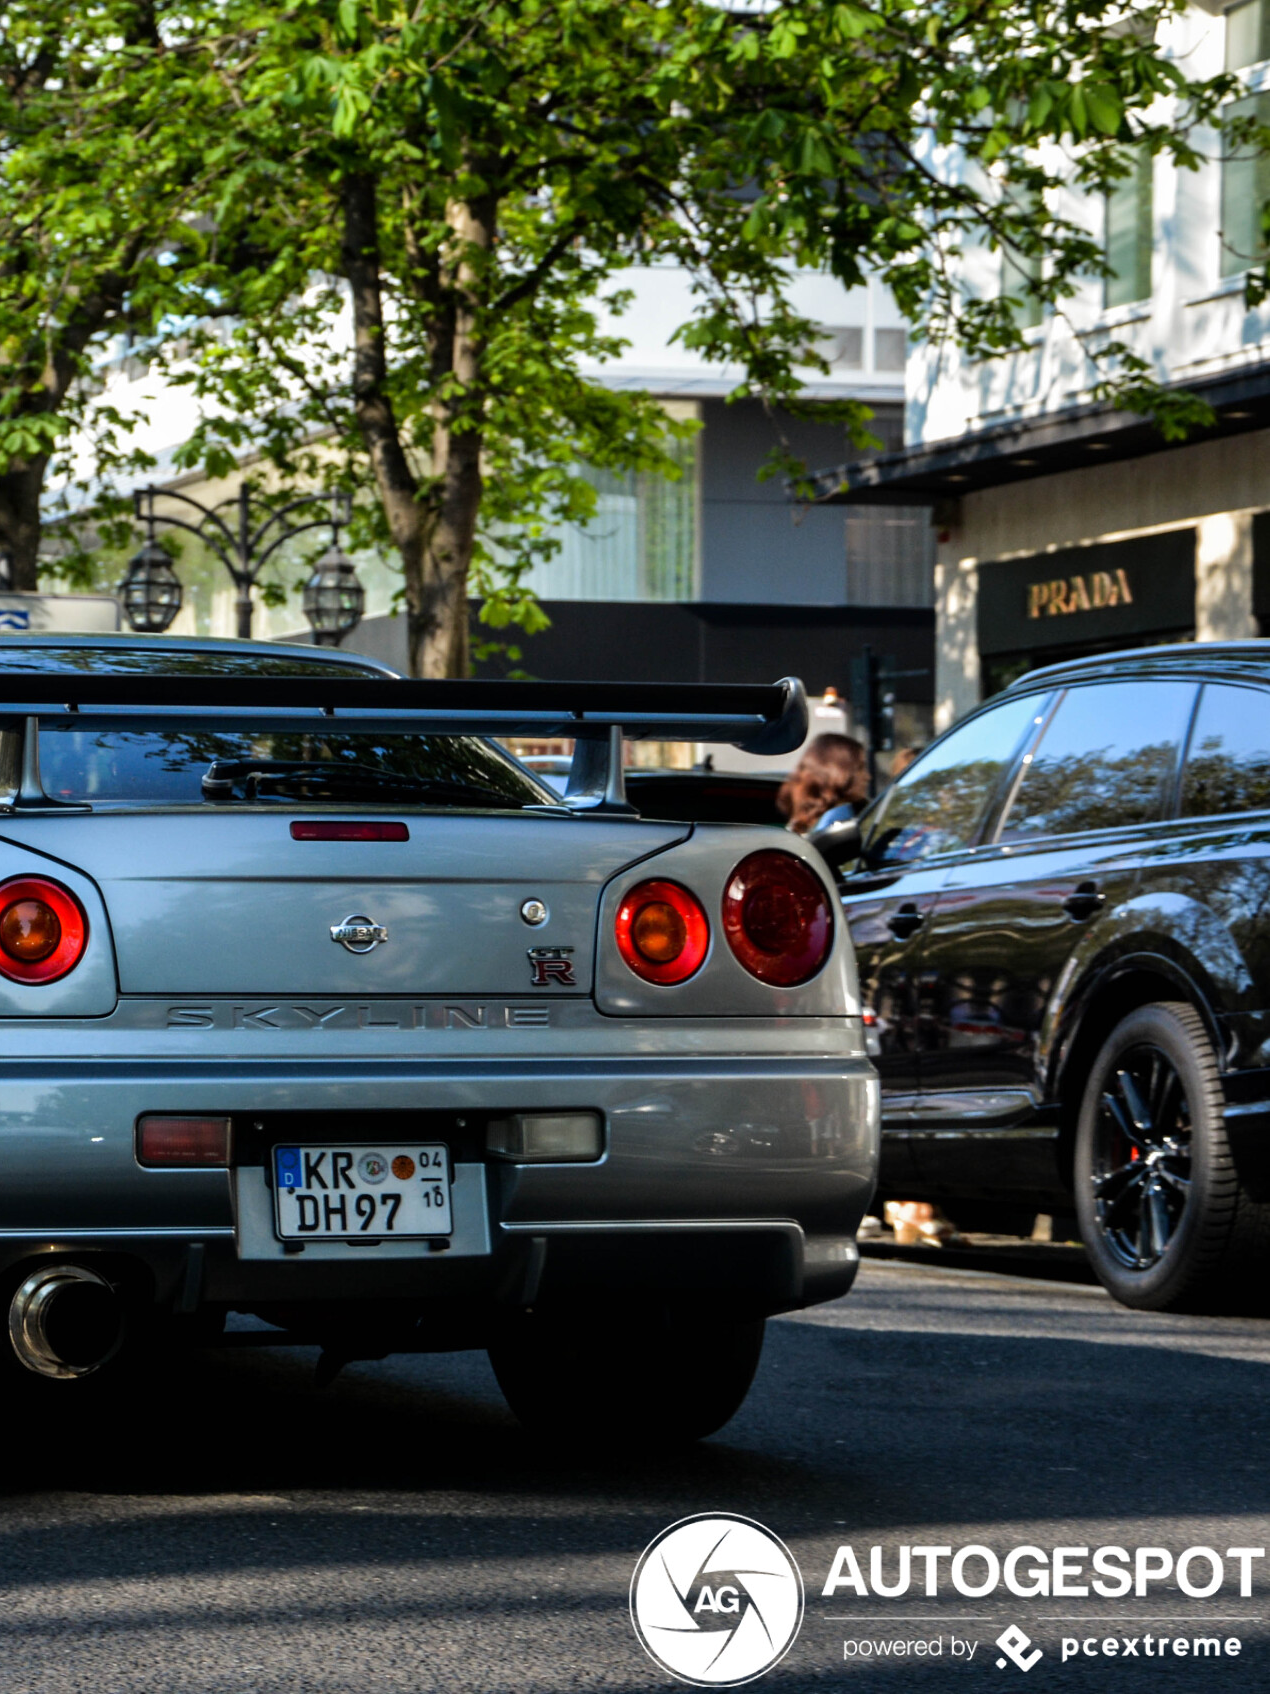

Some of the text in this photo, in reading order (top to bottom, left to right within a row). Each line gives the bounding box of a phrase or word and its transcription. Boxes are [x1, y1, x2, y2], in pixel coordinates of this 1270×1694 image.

[1029, 568, 1132, 618] PRADA
[337, 926, 382, 940] NISSAN
[531, 959, 576, 985] R
[167, 1006, 550, 1030] SKYLINE
[305, 1152, 356, 1189] KR
[419, 1152, 442, 1168] 04
[284, 1172, 294, 1185] D
